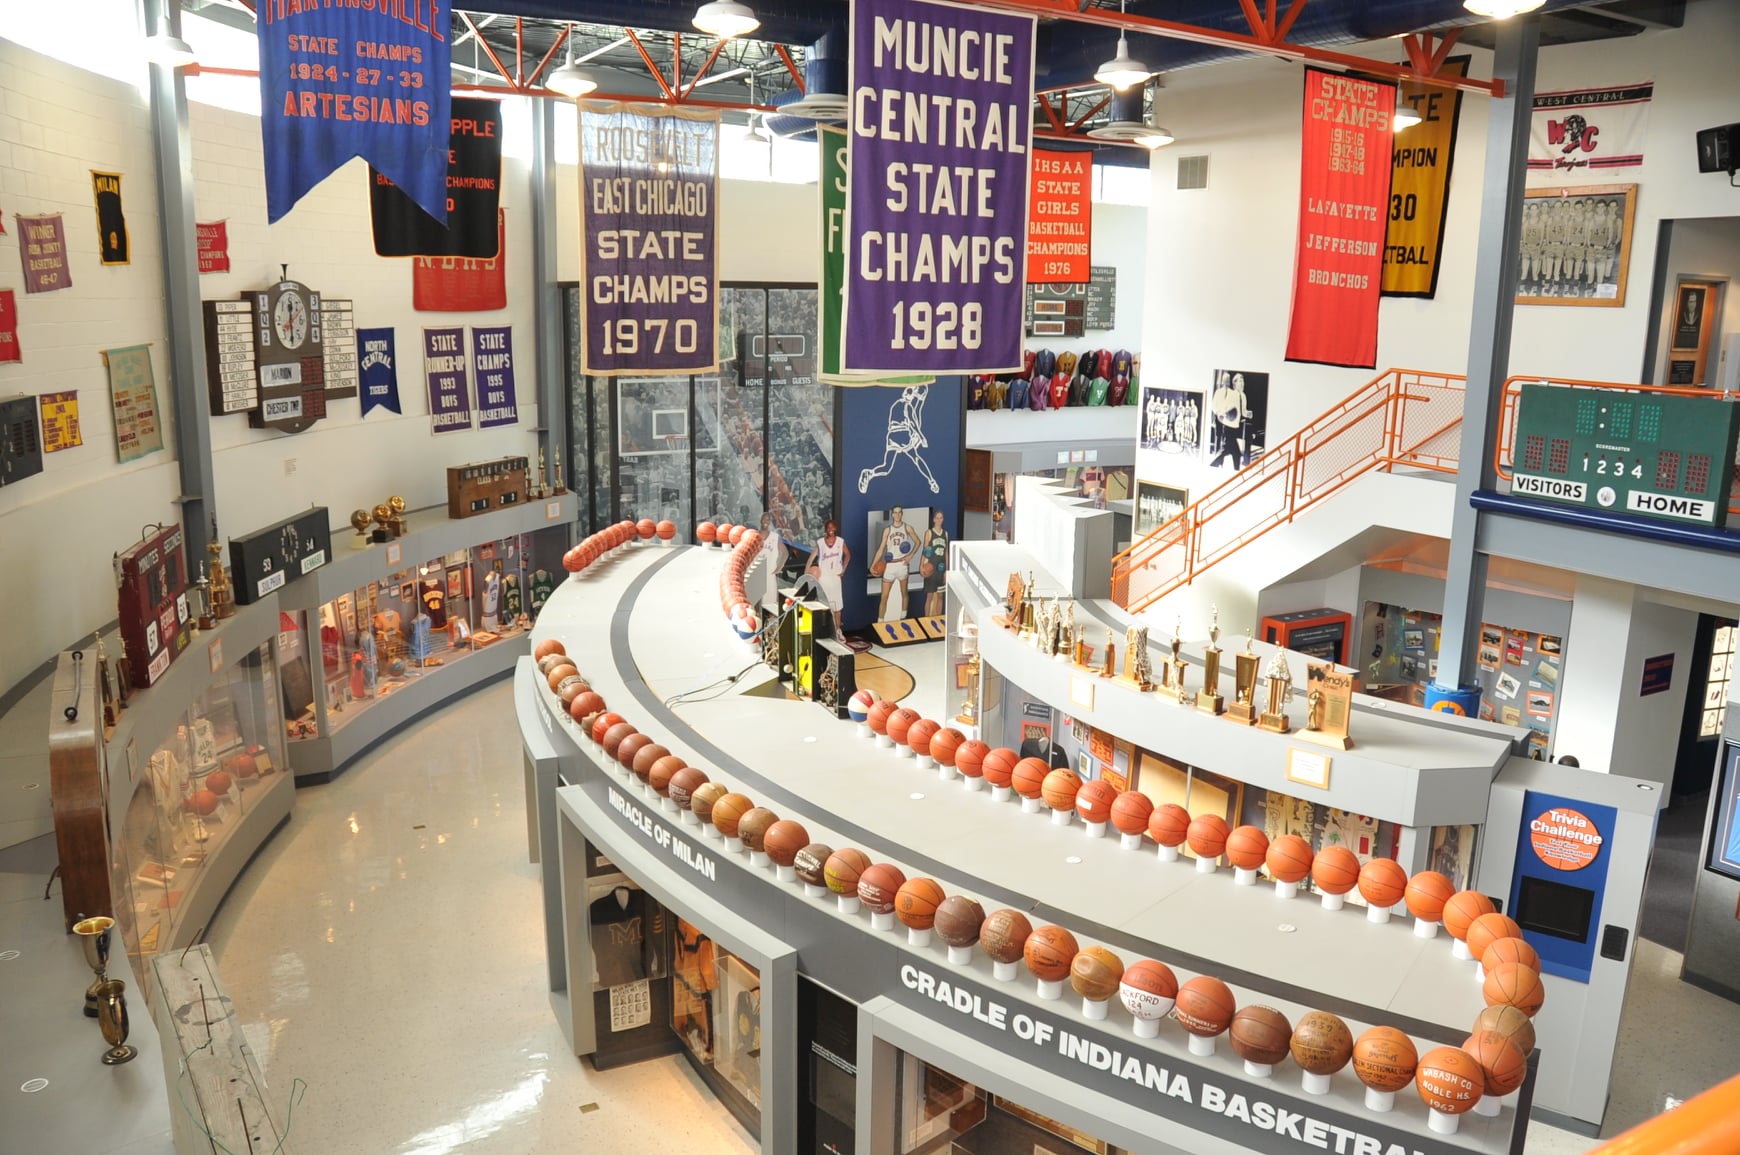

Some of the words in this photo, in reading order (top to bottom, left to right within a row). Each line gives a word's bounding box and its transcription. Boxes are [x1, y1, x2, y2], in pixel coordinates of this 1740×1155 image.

[288, 34, 338, 55] STATE
[356, 41, 422, 63] CHAMPS
[874, 15, 1013, 84] MUNCIE
[290, 63, 337, 82] 1924
[356, 67, 381, 85] 27
[399, 71, 423, 88] 33
[1320, 76, 1378, 106] STATE
[1537, 96, 1567, 107] WEST
[1573, 92, 1625, 104] CENTRAL
[284, 90, 429, 126] ARTESIANS
[1311, 98, 1389, 132] CHAMPS
[451, 118, 496, 138] PPLE
[855, 86, 1025, 154] CENTRAL
[1035, 158, 1084, 175] IHSAA
[96, 177, 119, 194] MILAN
[446, 176, 496, 190] CHAMPIONS
[886, 162, 996, 218] STATE
[1037, 180, 1081, 195] STATE
[593, 178, 632, 215] EAST
[636, 179, 707, 217] CHICAGO
[1037, 200, 1080, 215] GIRLS
[1391, 193, 1417, 222] 30
[1308, 197, 1377, 221] LAFAYETTE
[1030, 221, 1085, 236] BASKETBALL
[598, 230, 704, 260] STATE
[1027, 241, 1088, 256] CHAMPIONS
[1306, 233, 1378, 256] JEFFERSON
[860, 231, 1015, 284] CHAMPS
[1044, 262, 1071, 275] 1976
[1308, 268, 1369, 289] BRONCHOS
[593, 275, 708, 305] CHAMPS
[891, 300, 983, 350] 1928
[365, 340, 387, 352] NORTH
[431, 335, 457, 351] STATE
[479, 333, 505, 349] STATE
[602, 319, 697, 355] 1970
[361, 352, 392, 371] CENTRAL
[426, 356, 465, 373] RUNNER-UP
[477, 353, 510, 370] CHAMPS
[745, 378, 763, 387] HOME
[792, 377, 812, 385] GUESTS
[433, 411, 470, 426] BASKETBALL
[480, 406, 515, 422] BASKETBALL
[1583, 457, 1589, 472] 1
[1596, 459, 1607, 475] 2
[1613, 461, 1625, 477] 3
[1631, 463, 1643, 480] 4
[1516, 477, 1583, 499] VISITORS
[1636, 494, 1704, 517] HOME
[1549, 810, 1587, 828] Trivia
[608, 786, 653, 837] MIRACLE
[653, 824, 671, 848] OF
[672, 836, 716, 882] MILAN
[1530, 820, 1603, 845] Challenge
[609, 917, 643, 945] M
[900, 964, 1006, 1032] CRADLE
[1012, 1014, 1052, 1047] OF
[1058, 1032, 1193, 1103] INDIANA
[1200, 1083, 1424, 1155] BASKETB
[1423, 1068, 1457, 1085] WABASH
[1422, 1080, 1451, 1099] NOBLE
[1429, 1098, 1456, 1112] 1962
